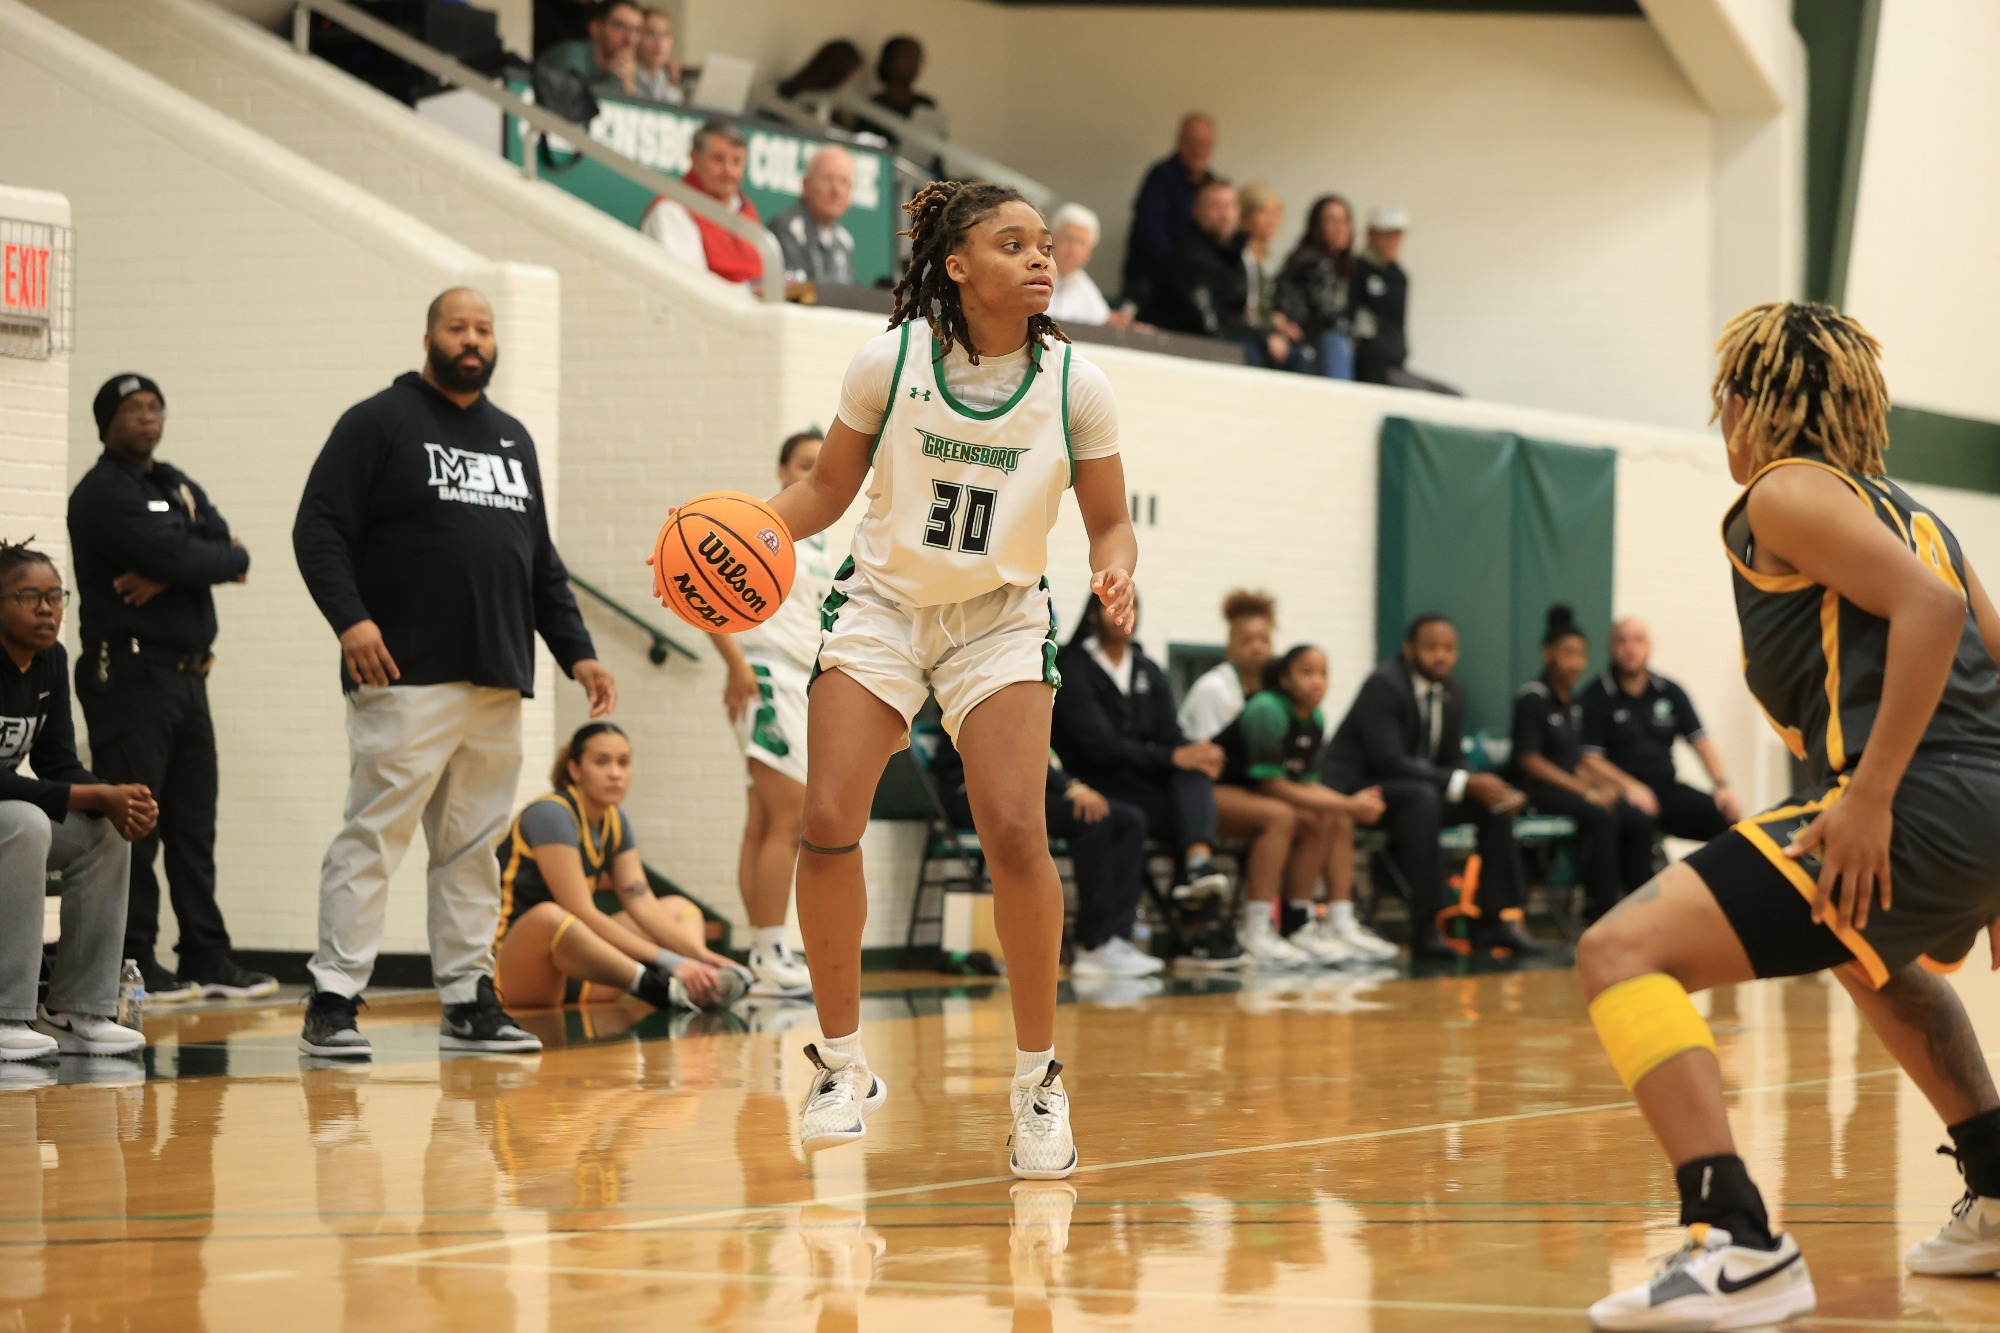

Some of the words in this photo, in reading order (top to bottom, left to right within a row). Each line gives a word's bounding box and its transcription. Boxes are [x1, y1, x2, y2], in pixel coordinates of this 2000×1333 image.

[3, 243, 50, 311] EXIT
[424, 442, 530, 499] MBU
[921, 432, 1022, 473] GREENSBORO
[438, 485, 527, 513] BASKETBALL
[922, 478, 998, 556] 30
[673, 572, 730, 627] NCAA
[698, 530, 767, 614] Wilson
